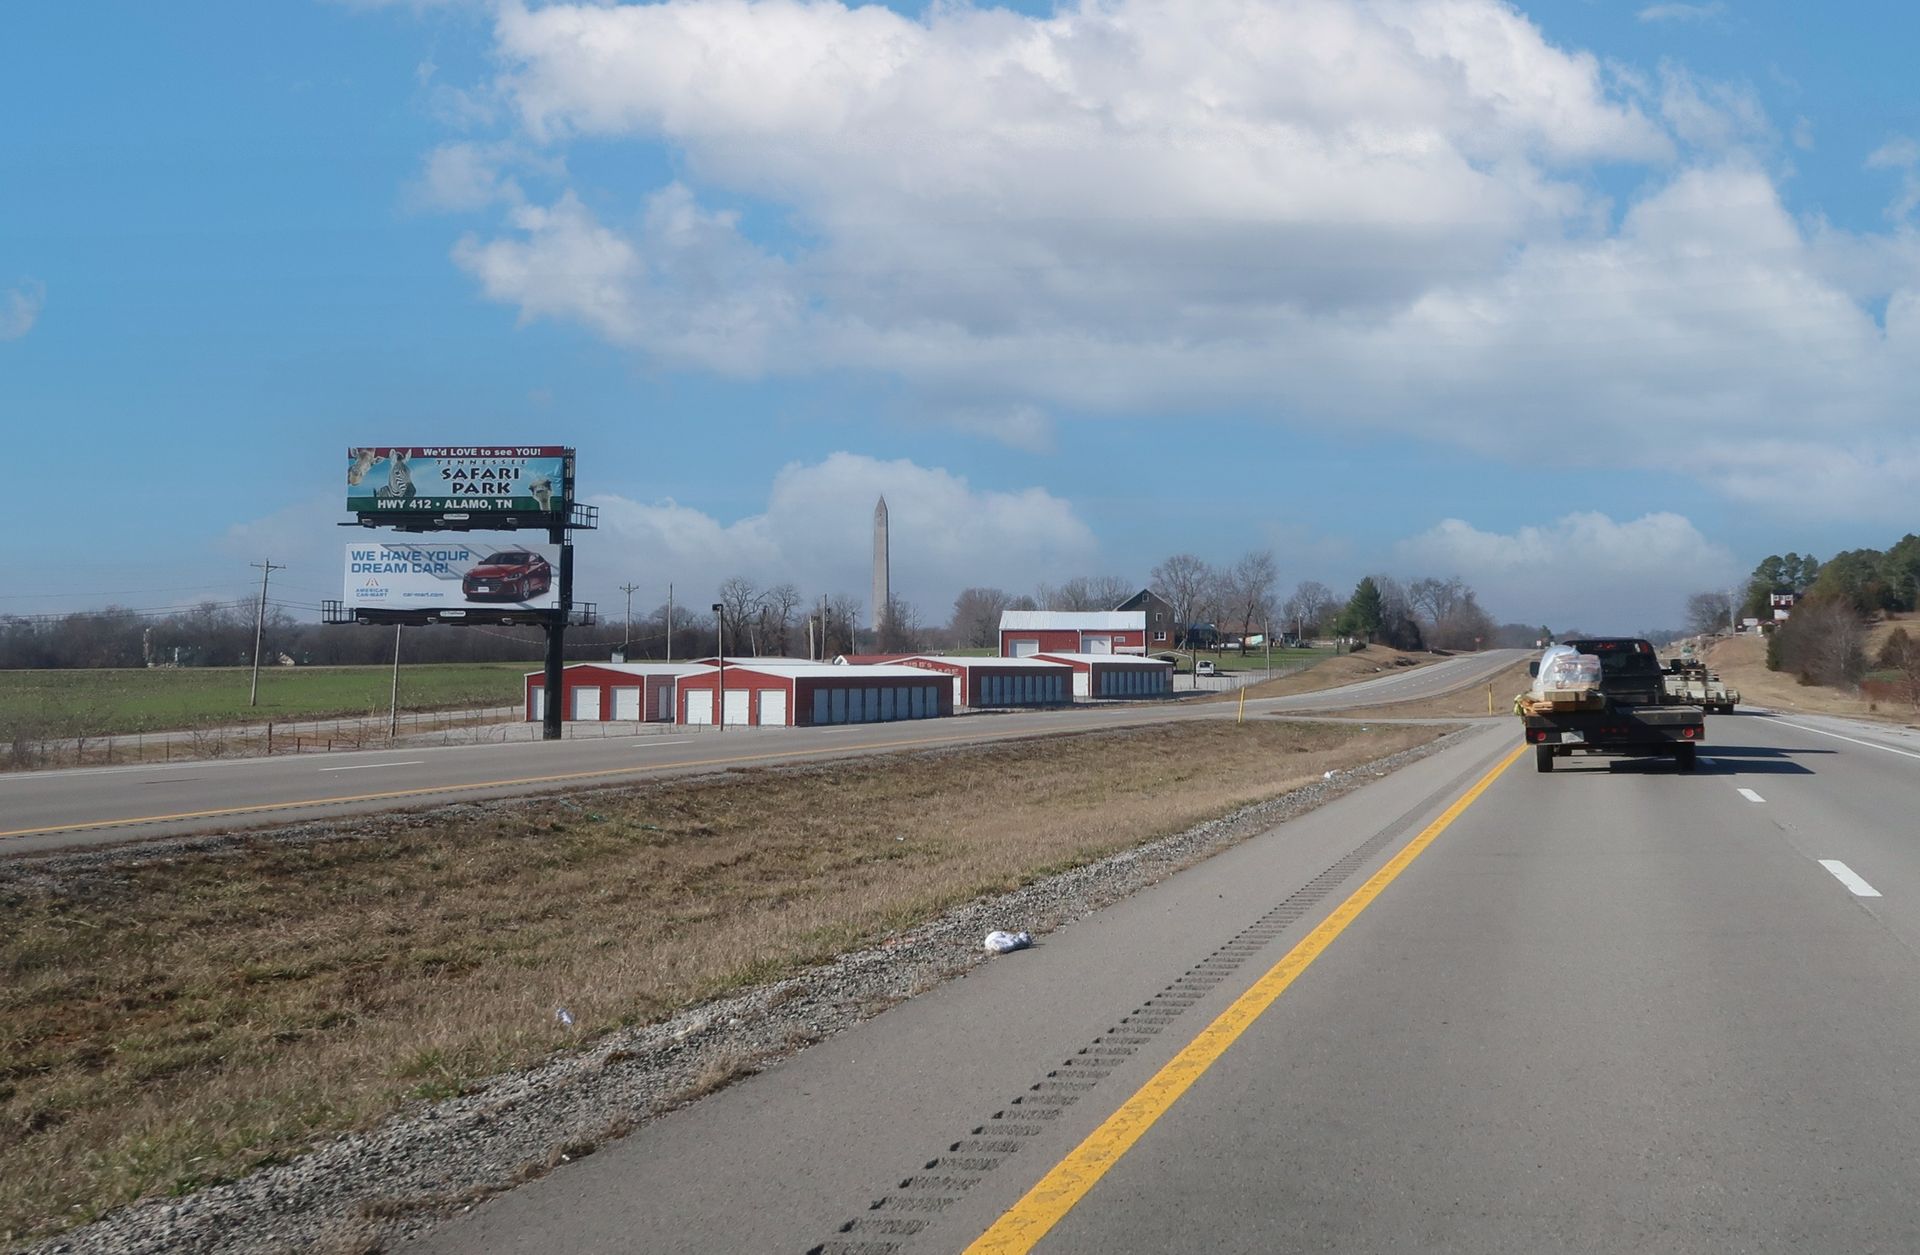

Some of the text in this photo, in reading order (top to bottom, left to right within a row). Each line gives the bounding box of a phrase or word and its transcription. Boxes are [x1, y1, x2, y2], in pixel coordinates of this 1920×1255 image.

[423, 448, 447, 456] We'd
[450, 448, 477, 456] LOVE
[480, 448, 491, 456] to
[515, 448, 541, 456] YOU!
[441, 467, 519, 480] SAFARI
[452, 482, 511, 494] PARK
[377, 499, 512, 510] HWY 412 ALAMO, TN
[351, 551, 469, 561] WE HAVE YOUR
[351, 563, 449, 574] DREAM CAR!
